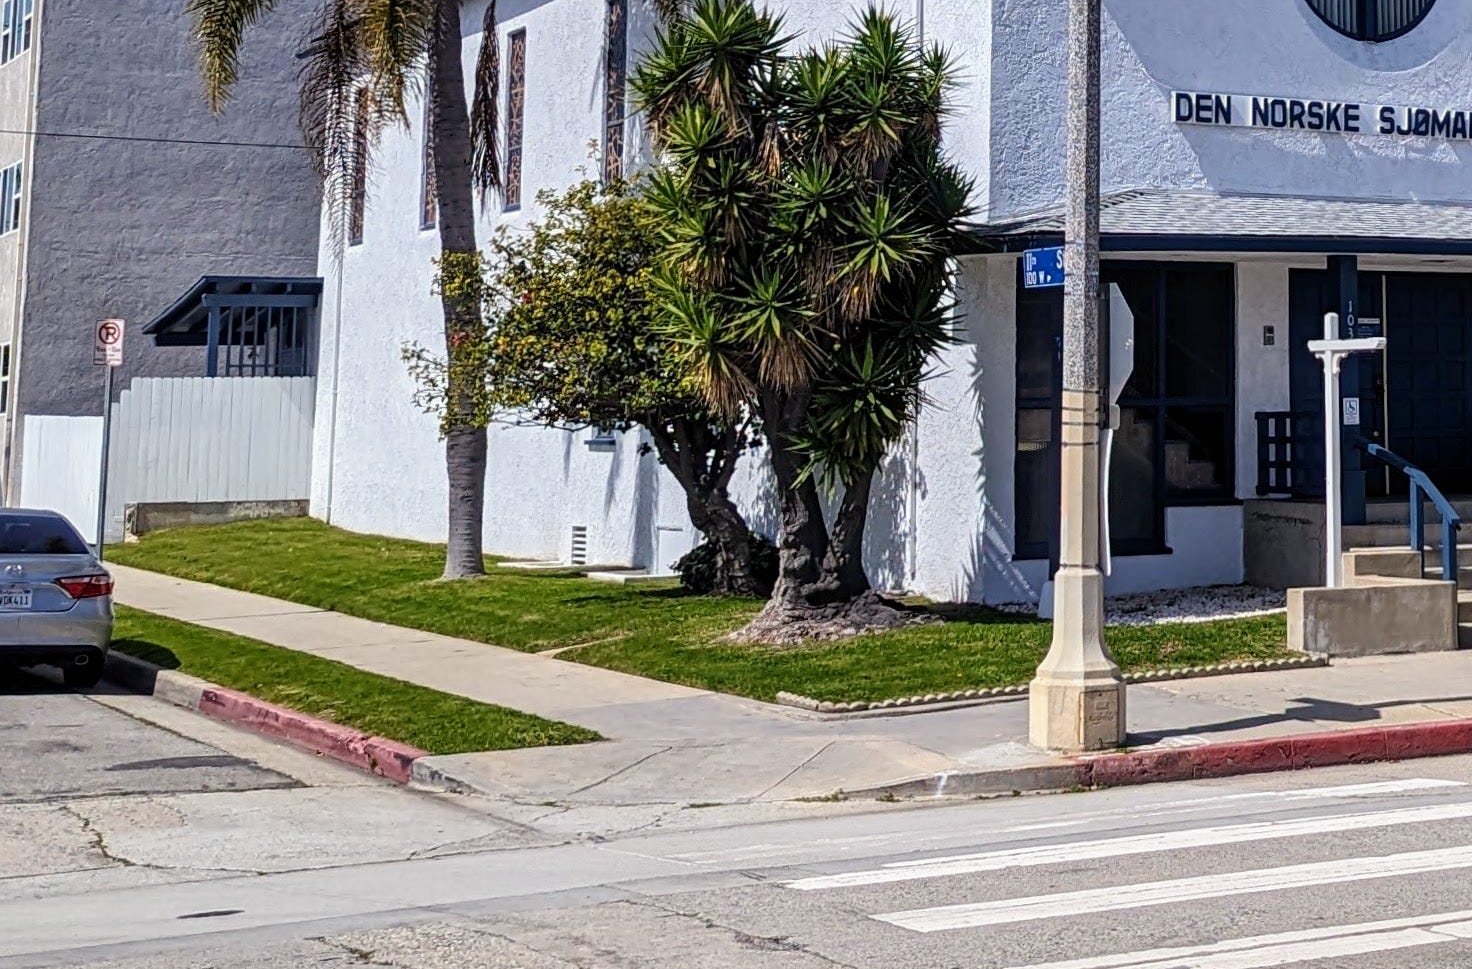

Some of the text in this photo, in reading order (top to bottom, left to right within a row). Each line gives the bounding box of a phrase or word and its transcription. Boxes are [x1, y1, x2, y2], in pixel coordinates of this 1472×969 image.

[1174, 92, 1232, 125] DEN
[1252, 97, 1361, 133] NORSKE
[1056, 249, 1064, 269] S
[1025, 270, 1045, 285] 100 W
